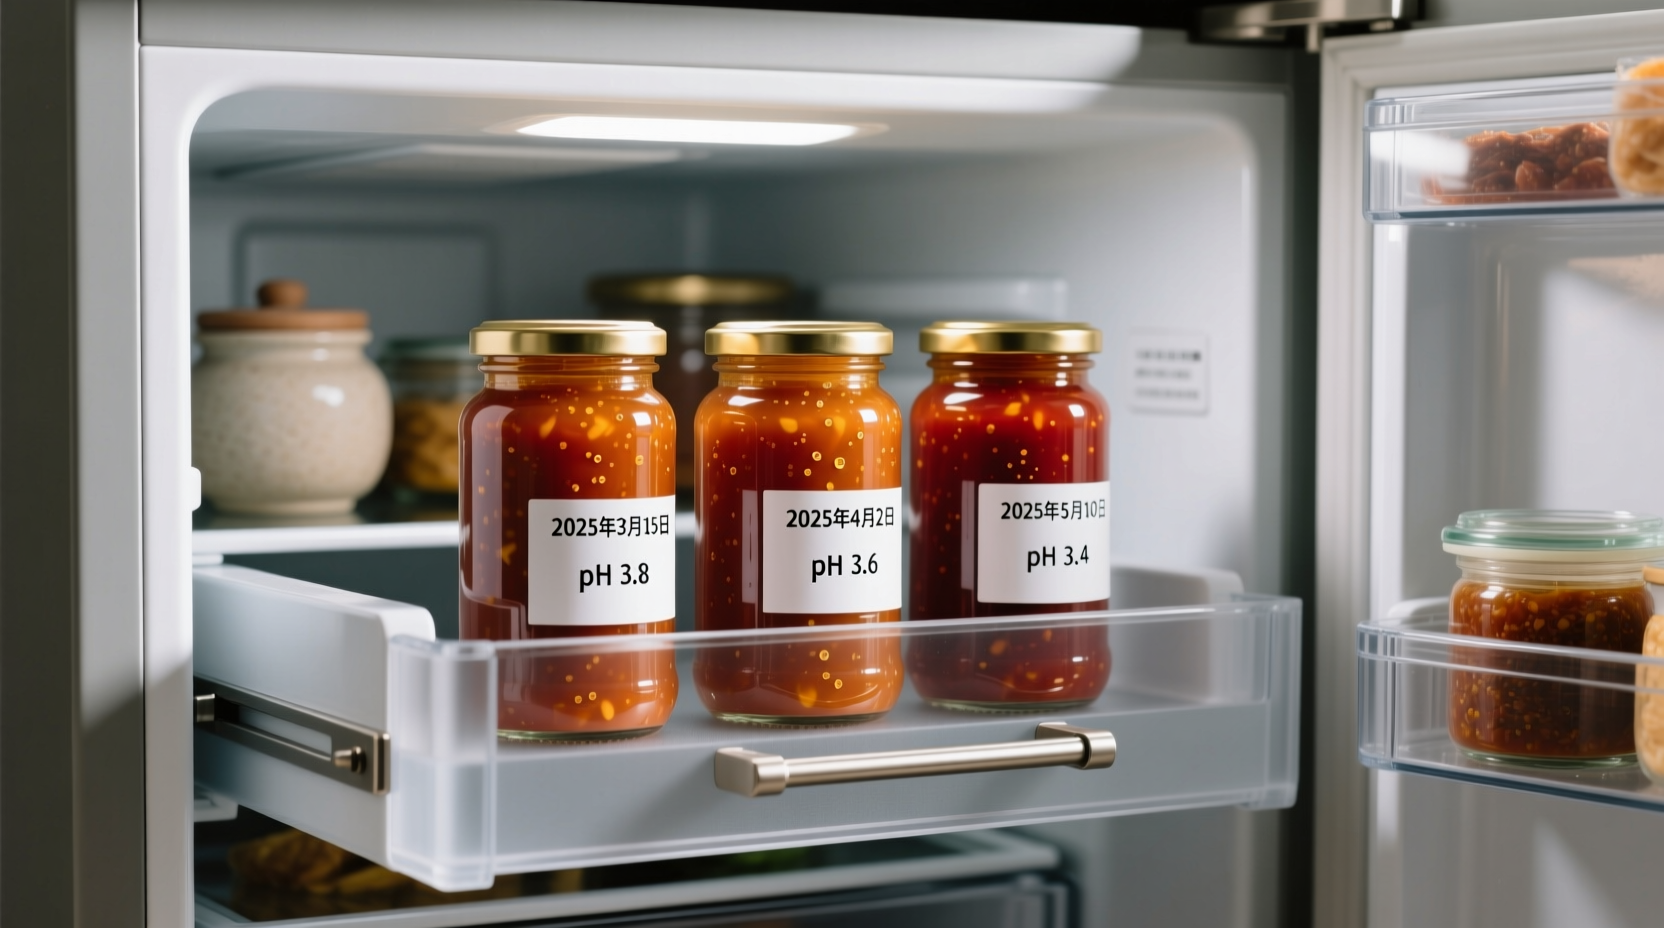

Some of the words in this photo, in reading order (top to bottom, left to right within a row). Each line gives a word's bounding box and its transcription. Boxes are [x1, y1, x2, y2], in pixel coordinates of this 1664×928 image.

[785, 506, 894, 529] 2025年4月2日
[1000, 499, 1105, 521] 2025年5月10日
[551, 514, 669, 538] 2025年3月15日
[811, 554, 843, 583] pH
[851, 552, 878, 575] 3.6
[1027, 545, 1056, 573] pH
[1063, 544, 1089, 566] 3.4
[579, 563, 612, 593] pH
[620, 562, 650, 585] 3.8
